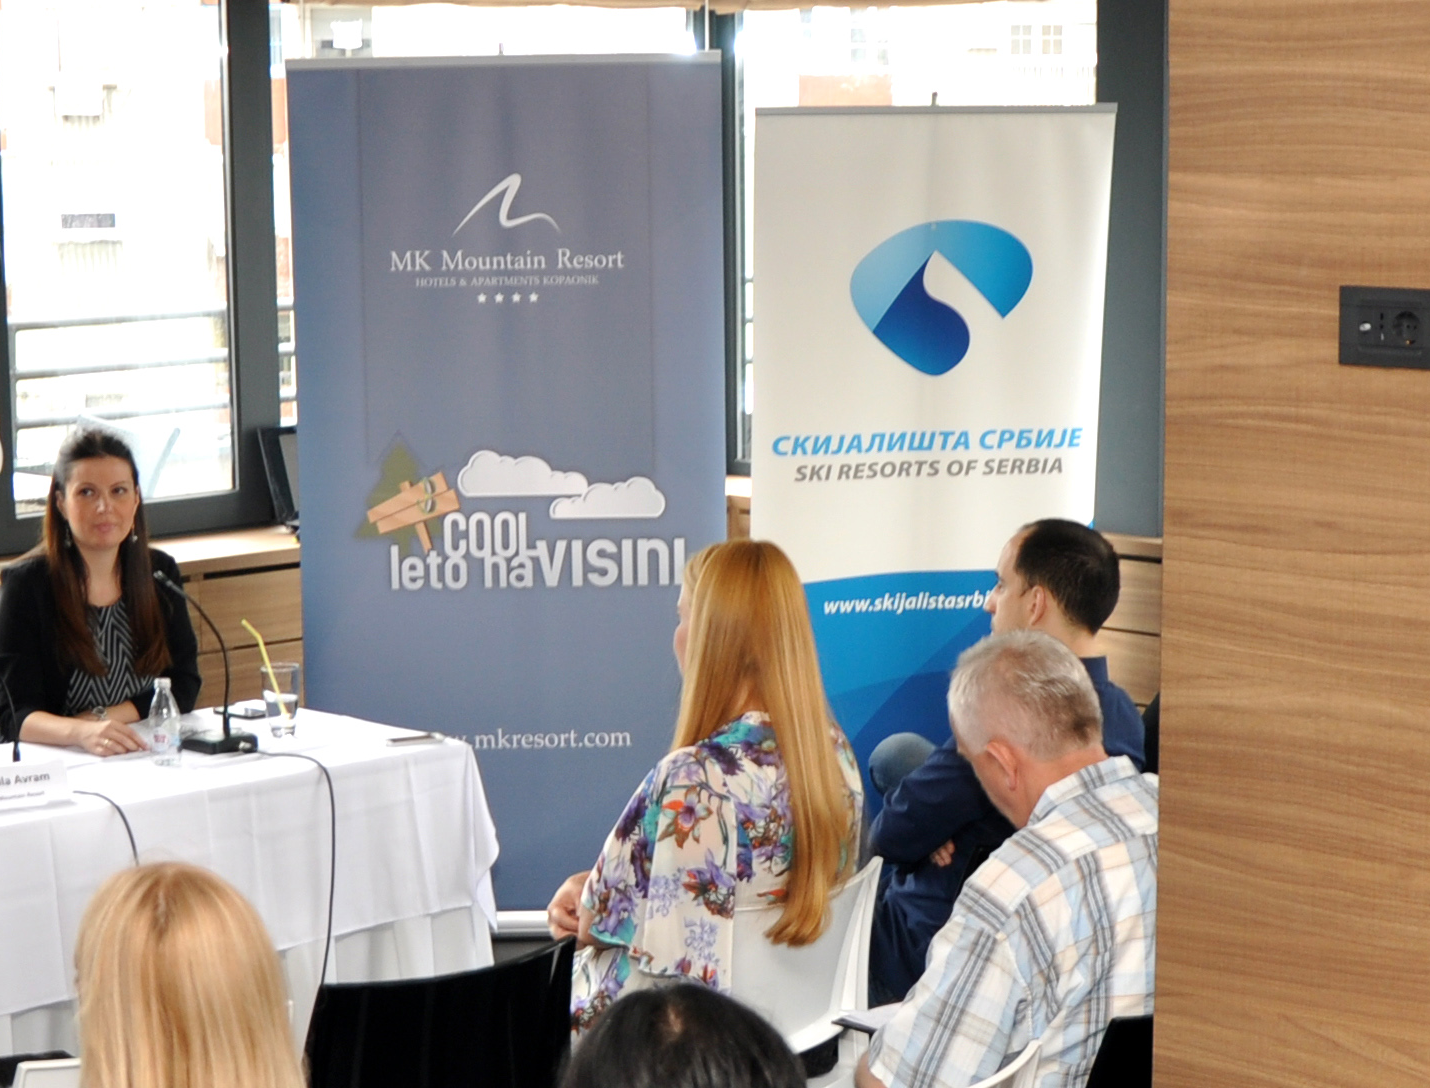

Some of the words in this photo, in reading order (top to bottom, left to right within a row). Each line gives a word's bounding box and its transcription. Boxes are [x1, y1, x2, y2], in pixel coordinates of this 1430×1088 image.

[390, 249, 432, 272] MK
[441, 249, 546, 271] Mountain
[556, 247, 624, 270] Resort
[415, 277, 456, 288] HOTELS
[458, 277, 467, 287] &
[470, 275, 540, 287] APARTMENTS
[543, 273, 599, 286] KOPAONIK
[771, 430, 970, 456] СКИЈАЛИШТА
[979, 427, 1083, 451] СРБИЈЕ
[794, 464, 832, 482] SKI
[837, 459, 940, 481] RESORTS
[946, 459, 978, 477] OF
[982, 456, 1063, 476] SERBIA
[443, 511, 539, 558] COOL
[389, 544, 468, 591] leto
[823, 590, 992, 615] www.skijalistasrbi
[14, 773, 50, 785] Avram
